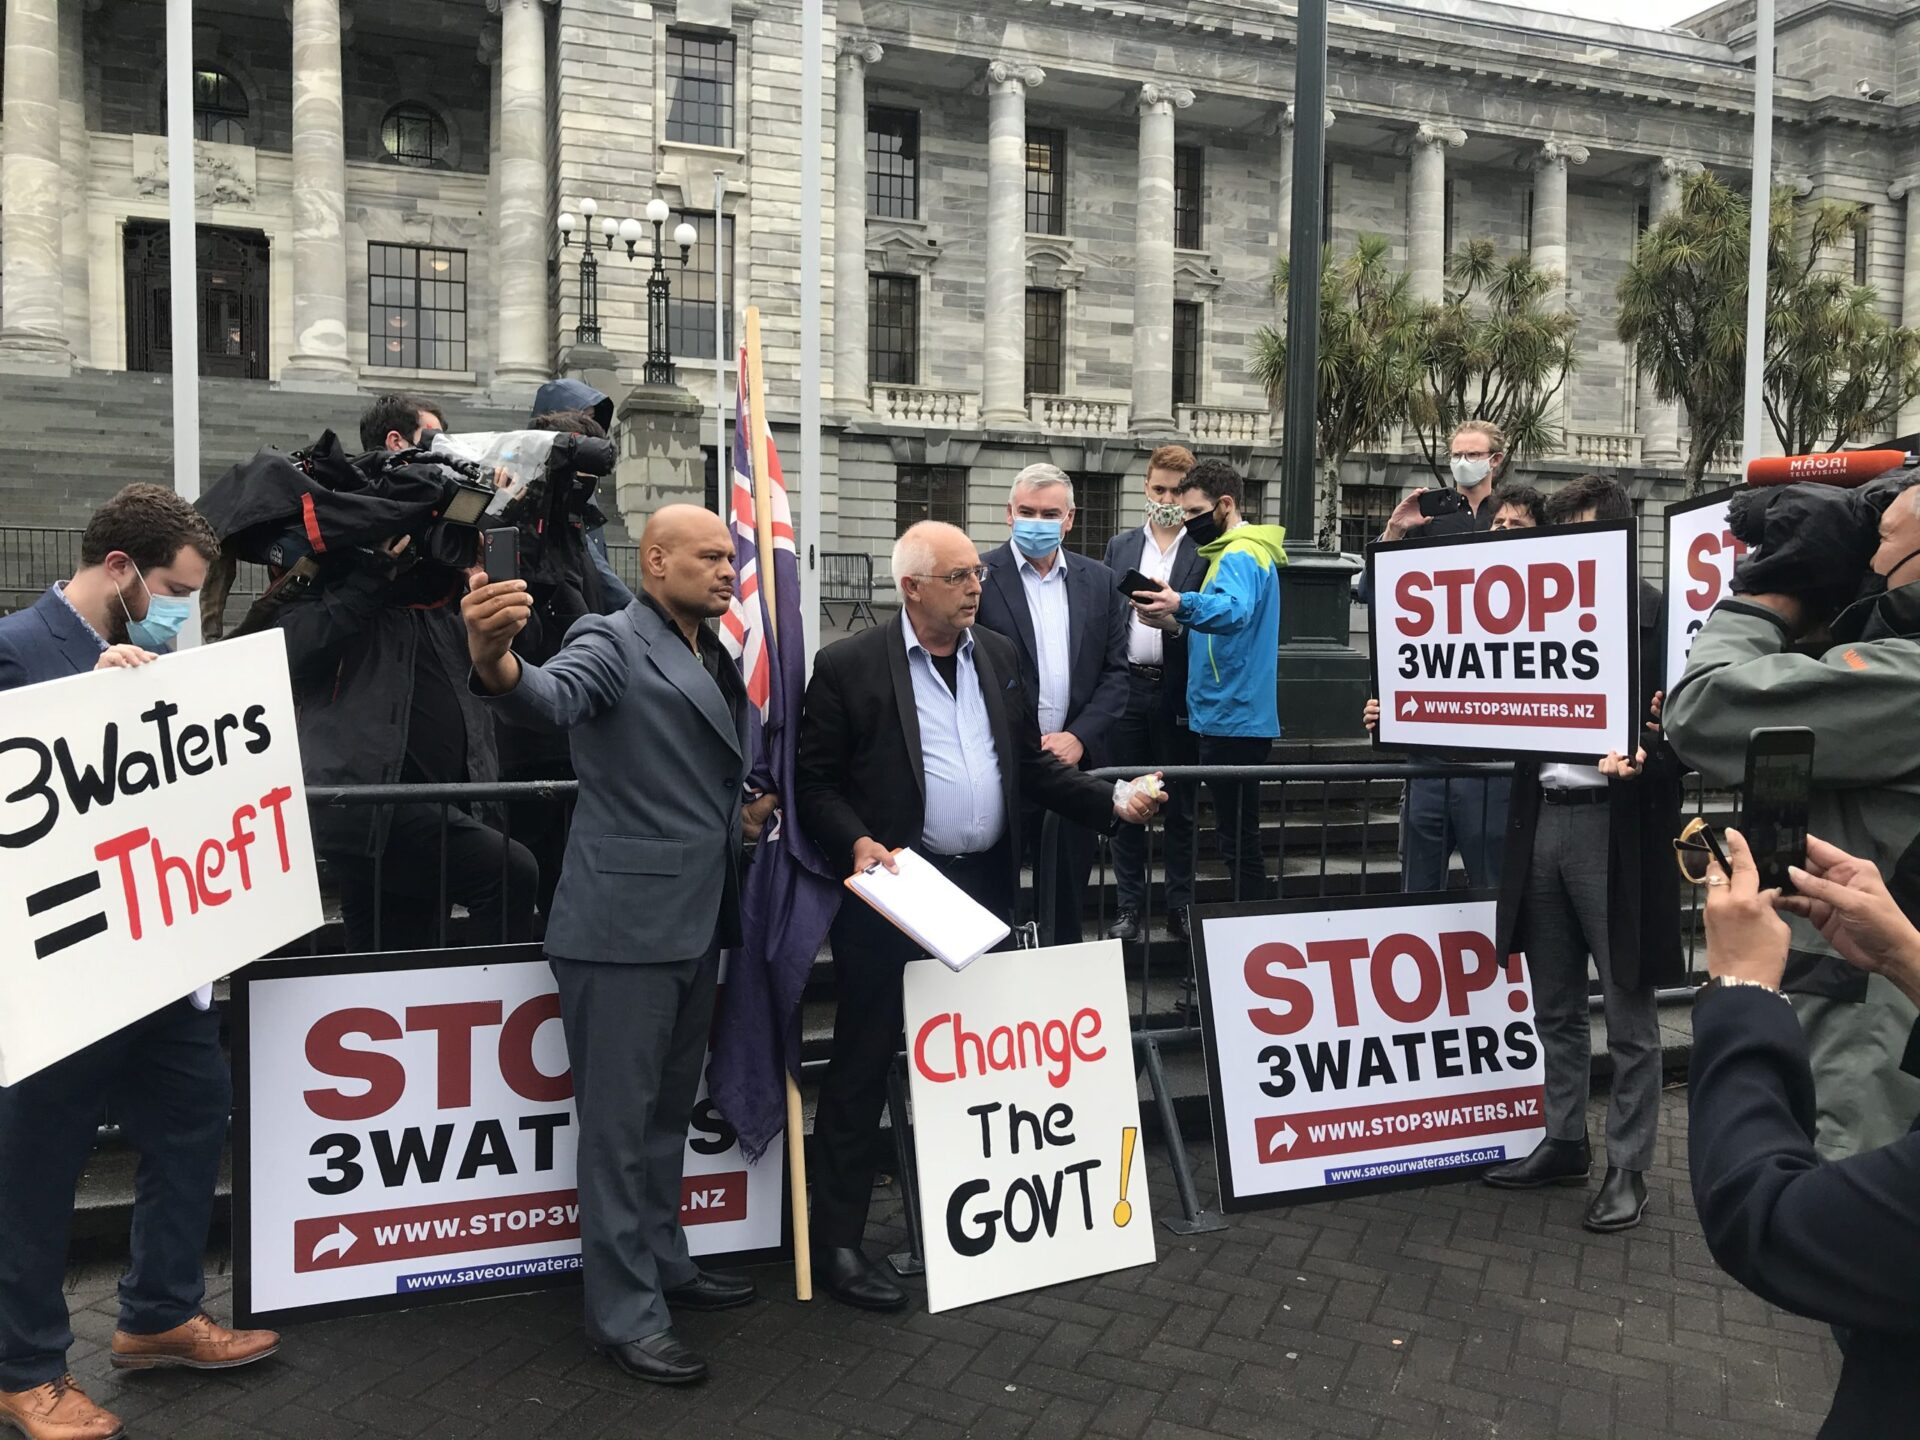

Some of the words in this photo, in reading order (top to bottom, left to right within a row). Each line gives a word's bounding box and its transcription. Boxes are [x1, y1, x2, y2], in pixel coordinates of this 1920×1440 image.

[1790, 468, 1847, 477] TELEVISION
[1395, 559, 1598, 637] STOP!
[1398, 639, 1600, 680] 3WATERS
[1424, 699, 1595, 718] WWW.STOP3WATERS.NZ
[0, 700, 271, 848] 3Waters
[1243, 930, 1529, 1036] STOP!
[914, 1008, 1107, 1088] Change
[1257, 1021, 1538, 1098] 3WATERS
[967, 1101, 1076, 1158] The
[1308, 1098, 1539, 1143] WWW.STOP3WATERS.NZ
[1331, 1149, 1500, 1181] www.saveourwaterassets.co.nz
